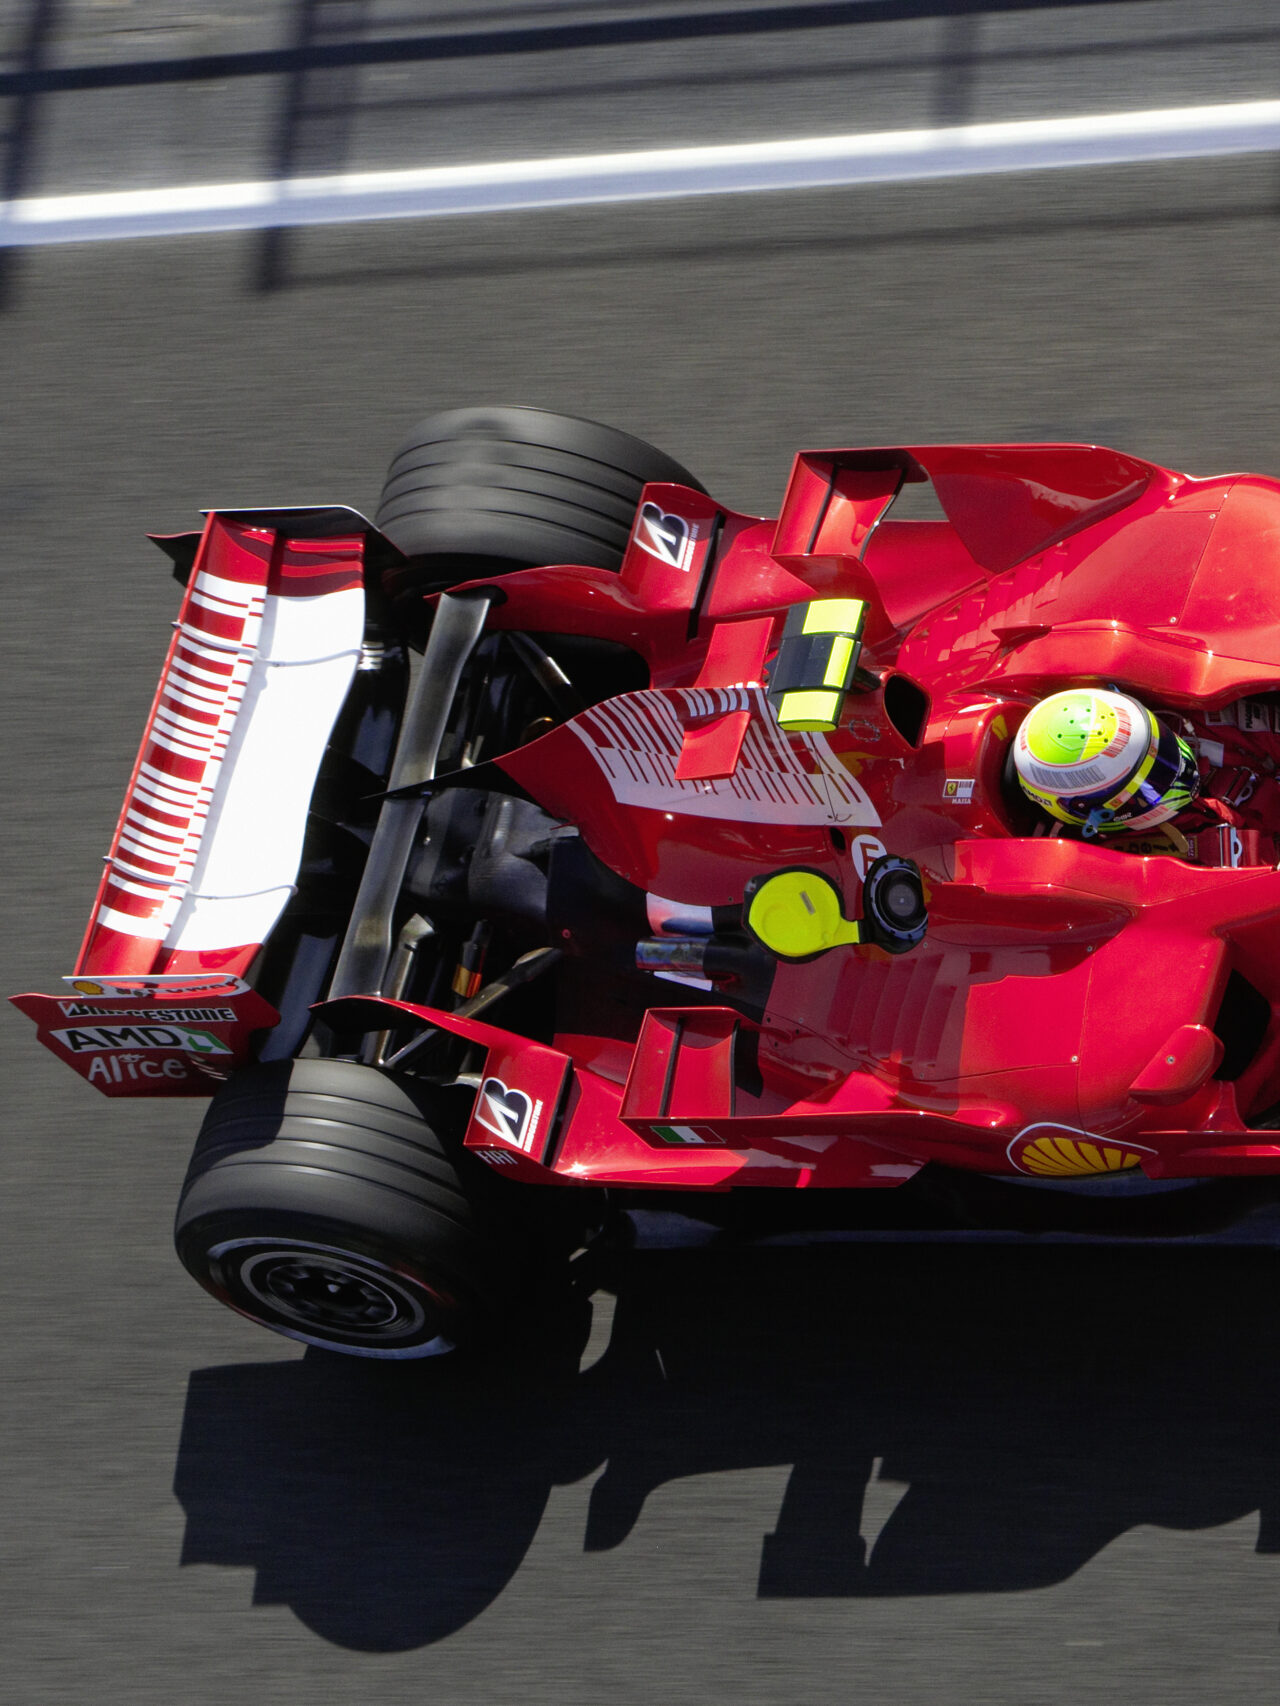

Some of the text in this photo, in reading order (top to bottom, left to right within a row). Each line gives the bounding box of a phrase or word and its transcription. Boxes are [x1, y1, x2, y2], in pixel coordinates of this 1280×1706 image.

[65, 1026, 183, 1051] AMD
[88, 1053, 187, 1084] Alice
[474, 1150, 519, 1165] FIAT
